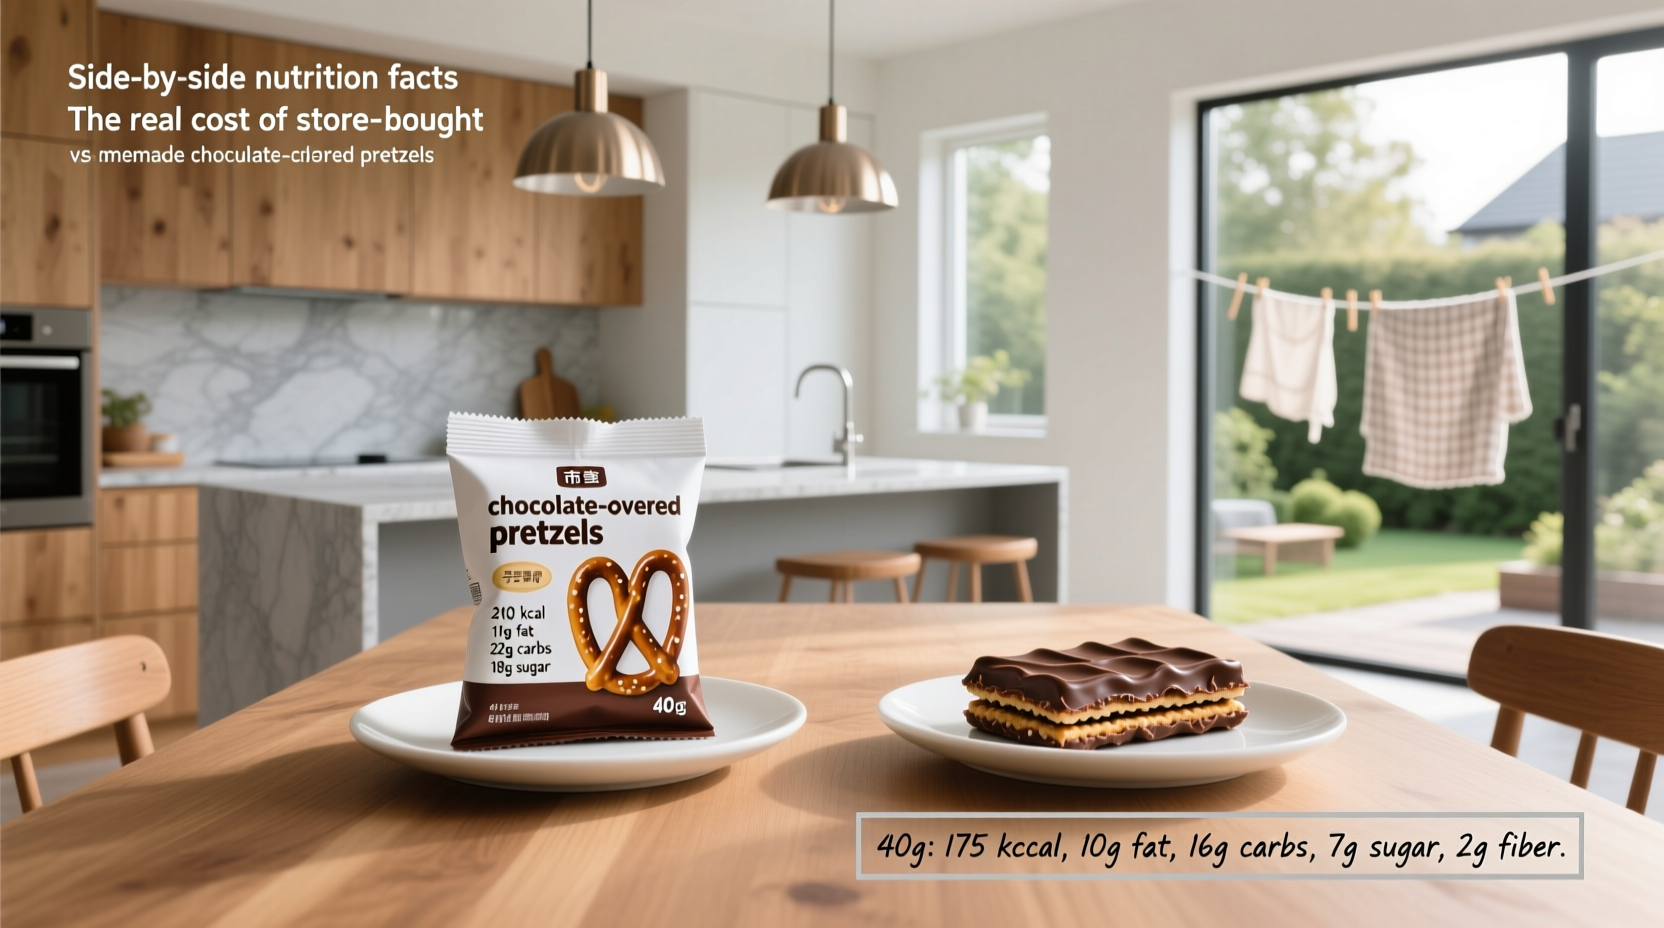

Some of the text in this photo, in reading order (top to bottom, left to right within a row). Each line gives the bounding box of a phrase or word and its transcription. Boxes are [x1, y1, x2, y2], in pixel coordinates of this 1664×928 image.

[487, 494, 681, 516] chocolate-overed
[489, 518, 604, 554] pretzels
[490, 605, 546, 621] 210 kcal
[516, 623, 534, 638] fat
[489, 640, 552, 659] 22g carbs
[490, 660, 551, 678] 18g sugar
[652, 696, 687, 716] 40g
